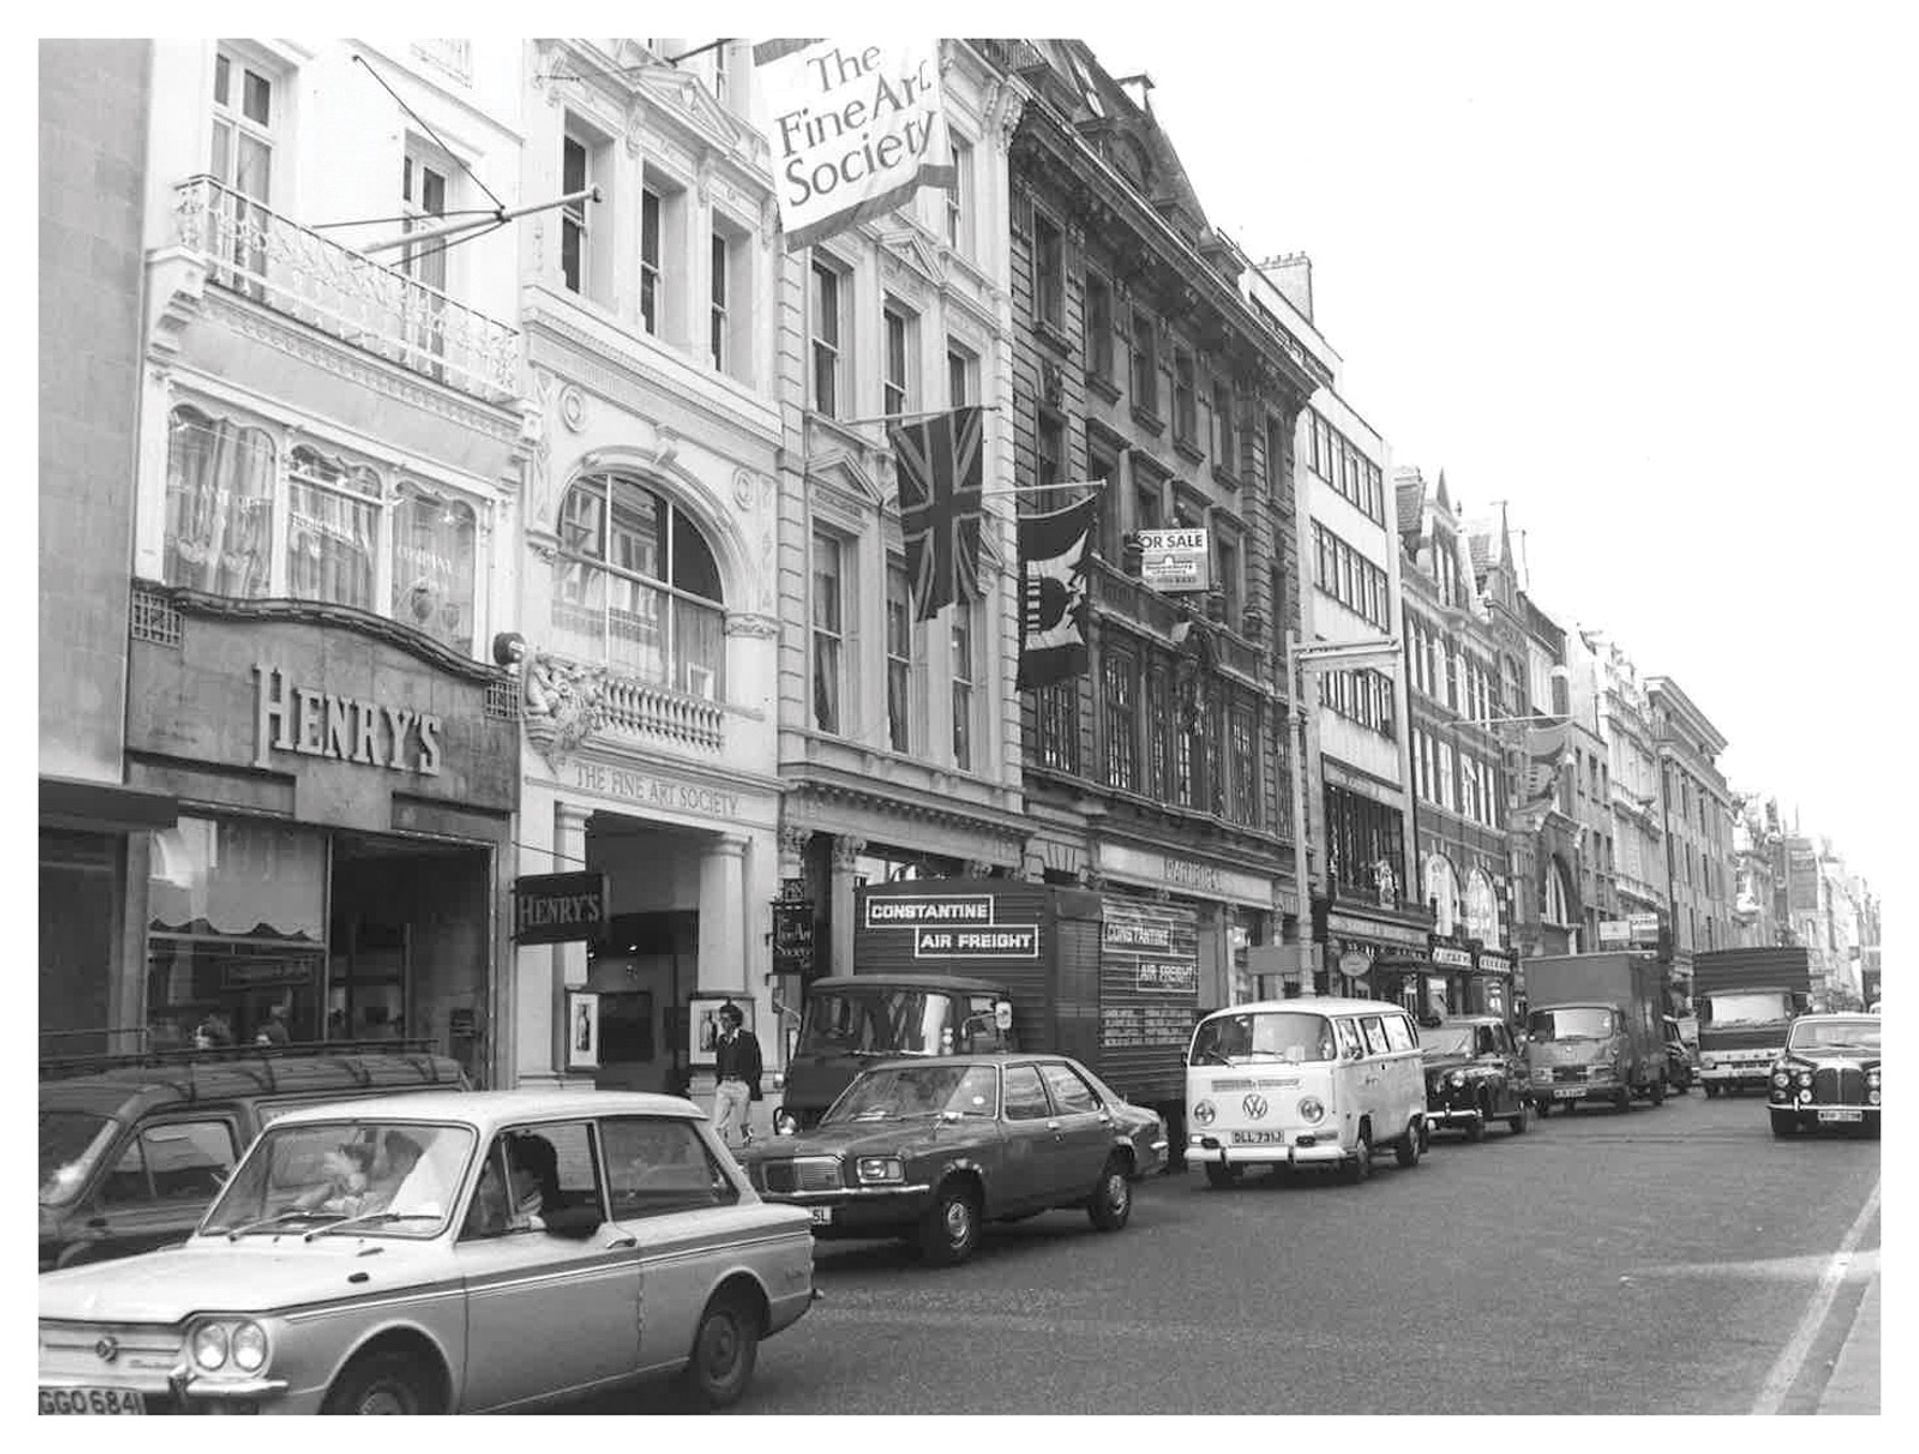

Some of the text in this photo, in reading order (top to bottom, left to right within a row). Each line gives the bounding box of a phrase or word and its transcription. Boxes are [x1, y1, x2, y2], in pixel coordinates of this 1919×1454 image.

[806, 45, 881, 93] The
[774, 58, 932, 158] Fine Art
[784, 109, 937, 208] Society
[1138, 535, 1202, 548] OR SALE
[251, 662, 443, 777] HENRY'S
[575, 762, 739, 816] THE FINE ART SOCIETY
[519, 895, 601, 925] HENRY'S
[871, 904, 988, 920] CONSTANTINE
[921, 933, 1033, 949] AIR FREIGHT
